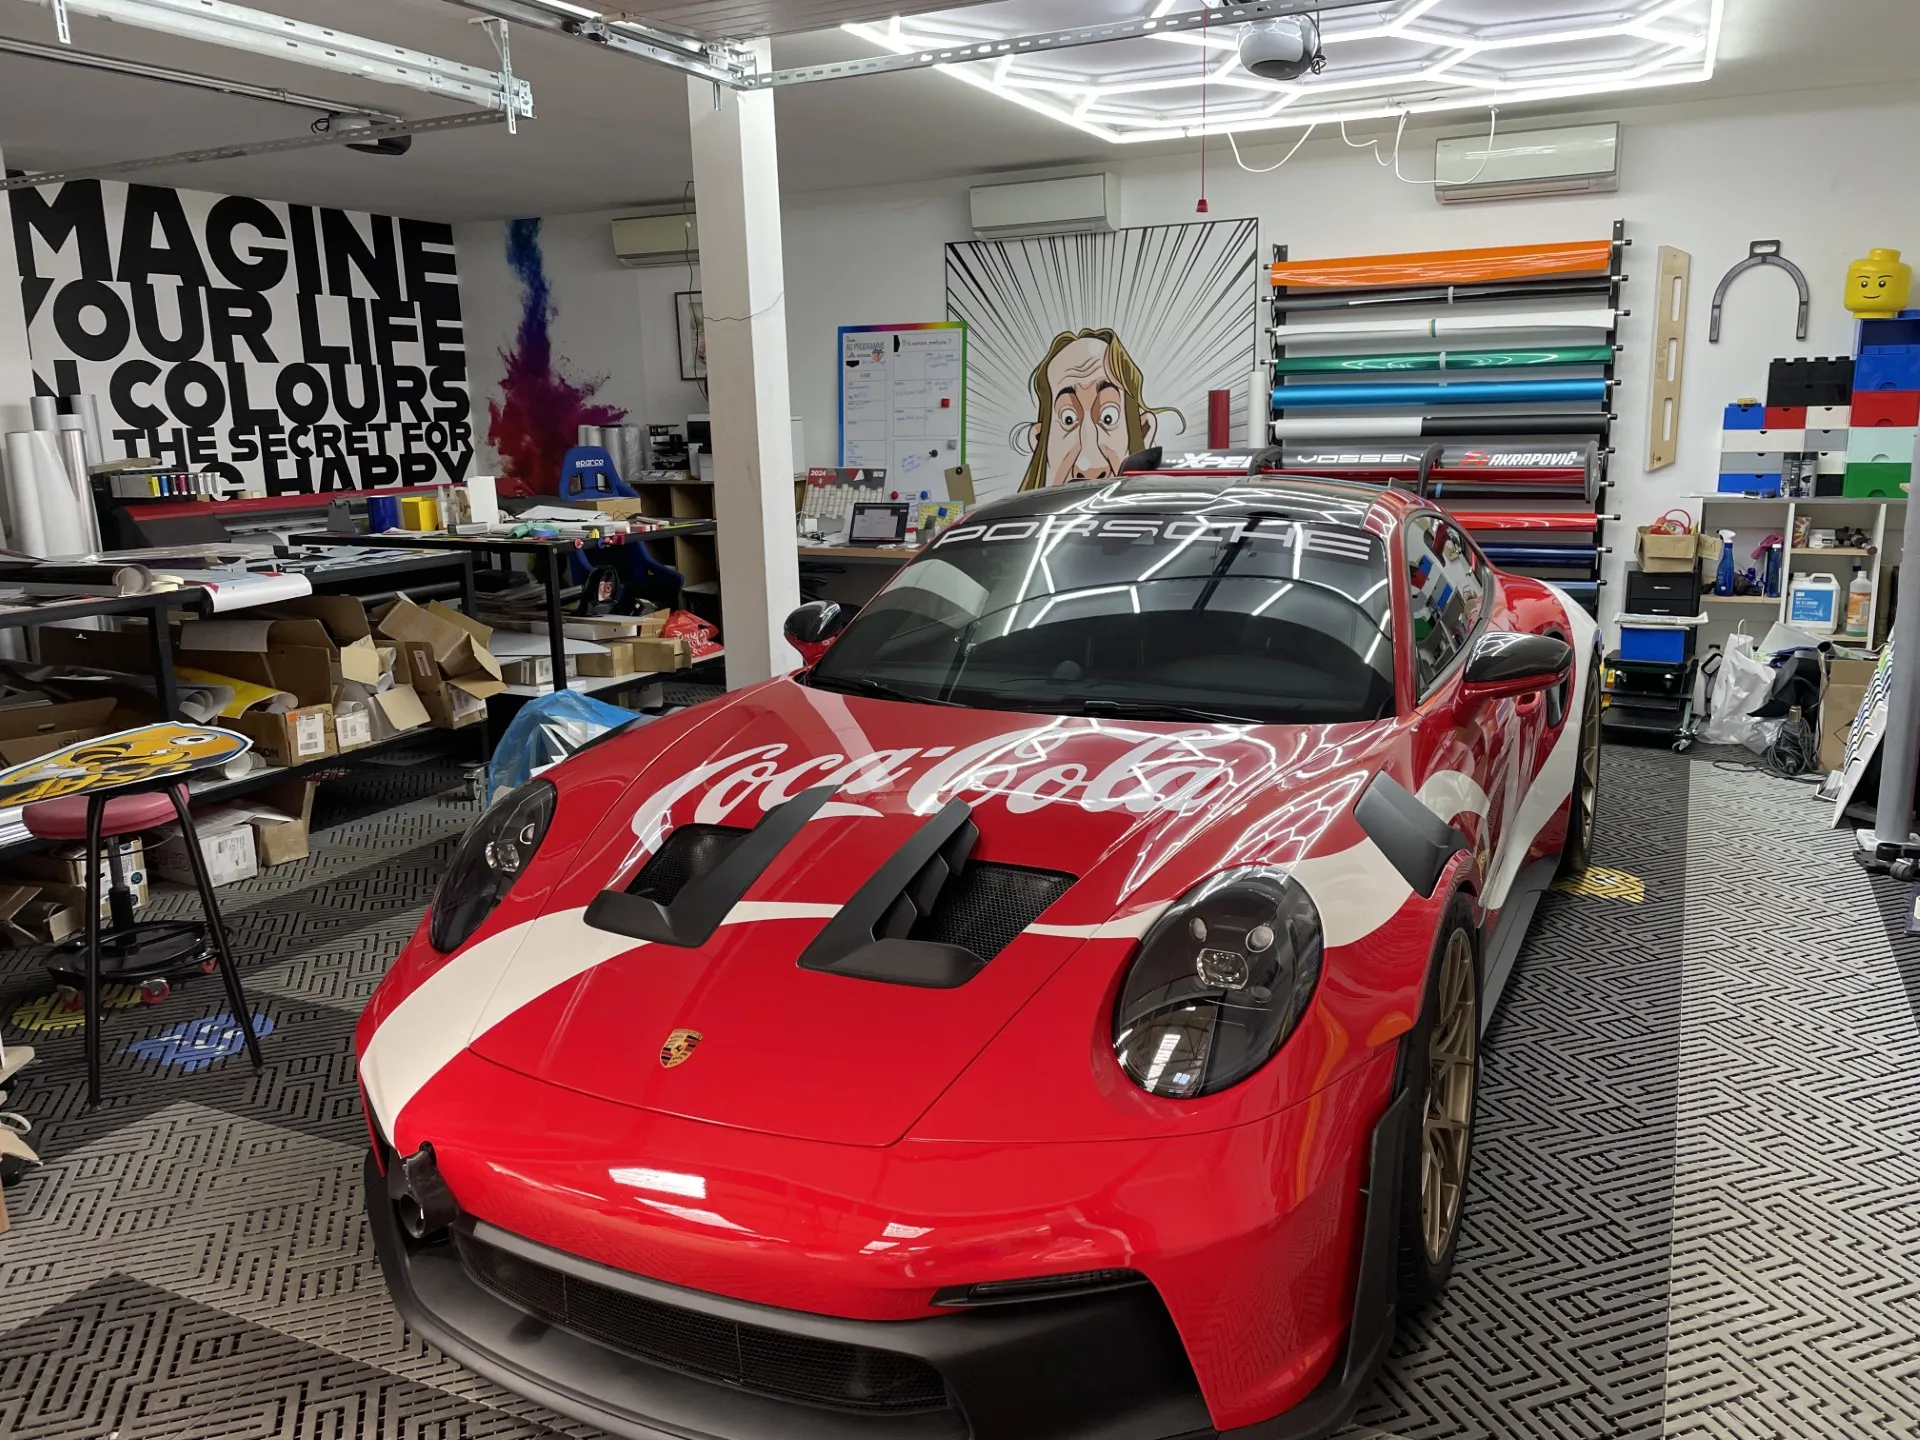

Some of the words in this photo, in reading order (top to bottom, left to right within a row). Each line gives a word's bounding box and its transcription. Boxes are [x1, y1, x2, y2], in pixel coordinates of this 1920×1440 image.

[297, 293, 466, 366] LIFE
[110, 359, 471, 428] COLOURS
[113, 427, 216, 469] THE
[228, 422, 401, 462] SECRET
[402, 421, 472, 458] FOR
[1297, 453, 1424, 464] VOSSEN
[265, 449, 475, 497] HAPPY
[932, 519, 1372, 561] PORSCHE
[631, 725, 1241, 856] Coca-Cola
